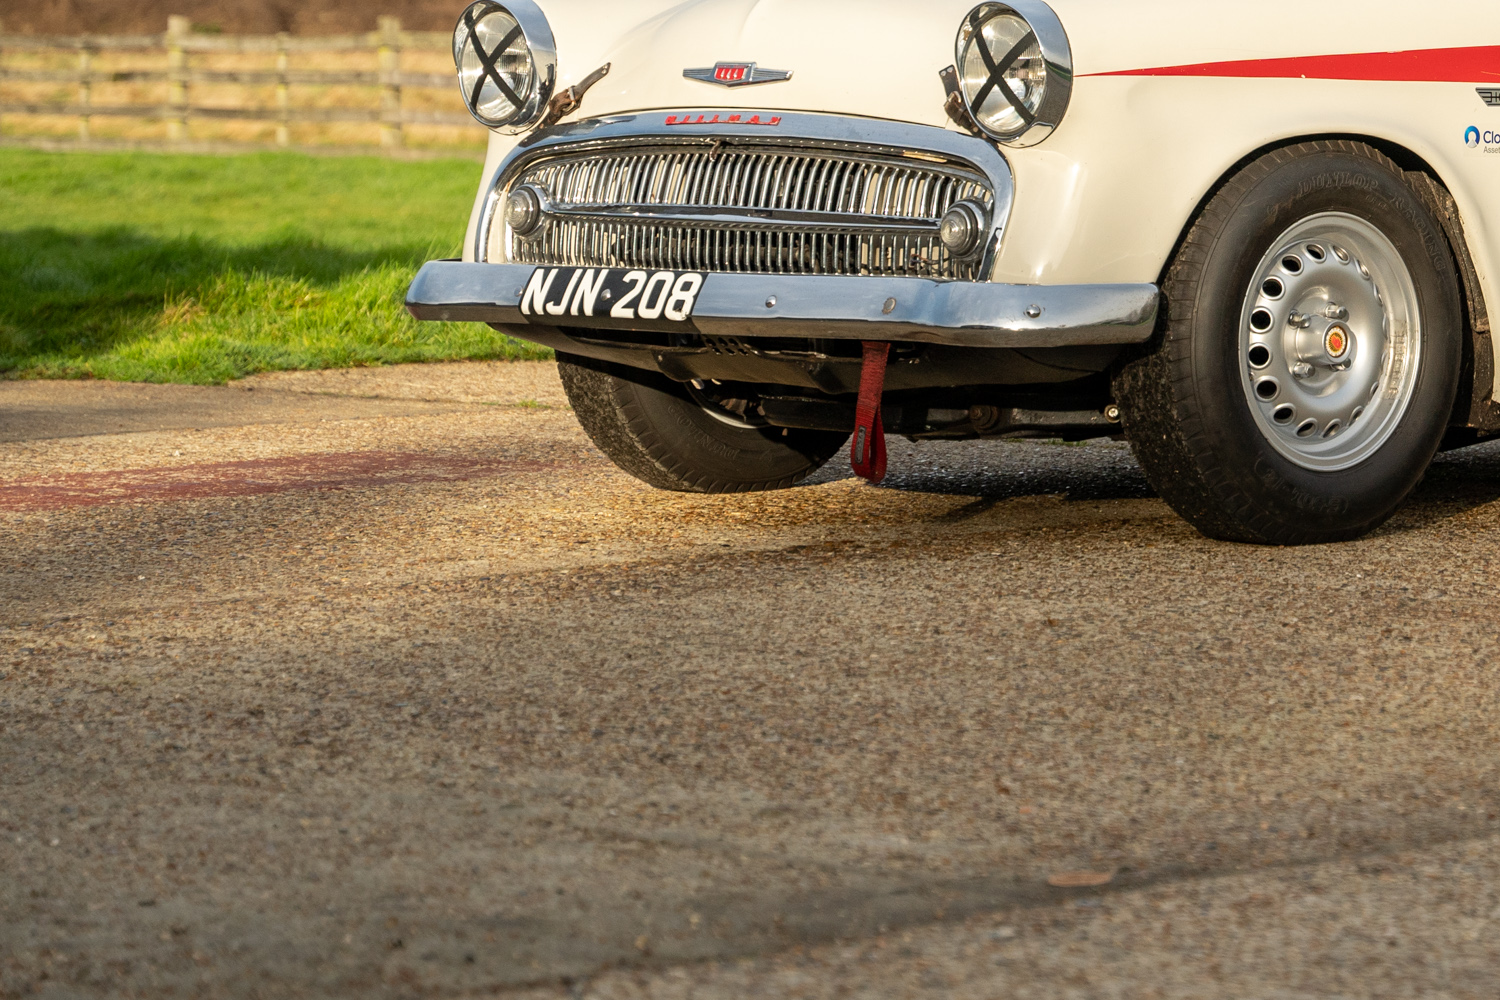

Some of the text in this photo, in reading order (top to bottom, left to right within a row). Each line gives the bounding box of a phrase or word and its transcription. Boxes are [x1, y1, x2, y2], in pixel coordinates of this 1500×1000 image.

[1483, 146, 1500, 154] Asset
[1297, 171, 1446, 271] DUNLOP RACING
[520, 268, 703, 321] NJN 208
